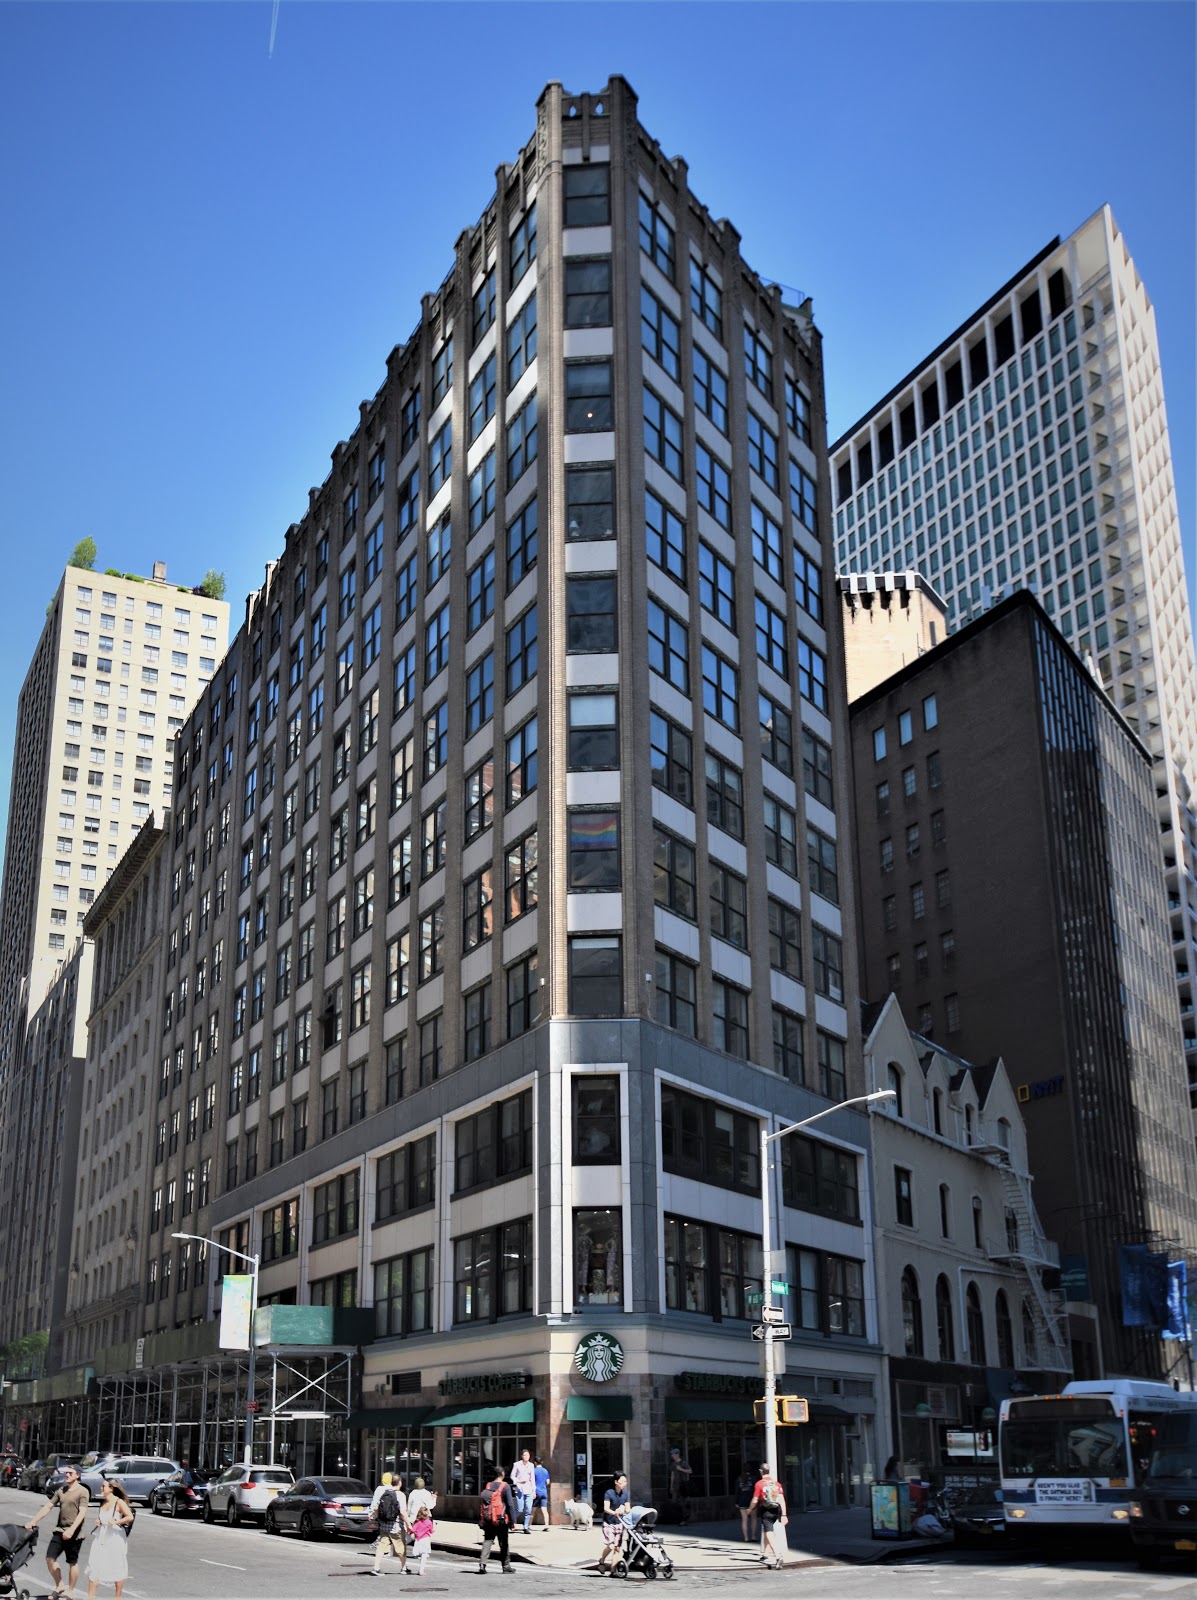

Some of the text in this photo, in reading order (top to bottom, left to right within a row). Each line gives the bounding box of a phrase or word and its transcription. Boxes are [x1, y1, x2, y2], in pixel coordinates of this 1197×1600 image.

[1031, 1075, 1064, 1098] NYIT
[438, 1372, 526, 1396] STARBUCKS COFFEE
[683, 1373, 745, 1393] STARBUCKS
